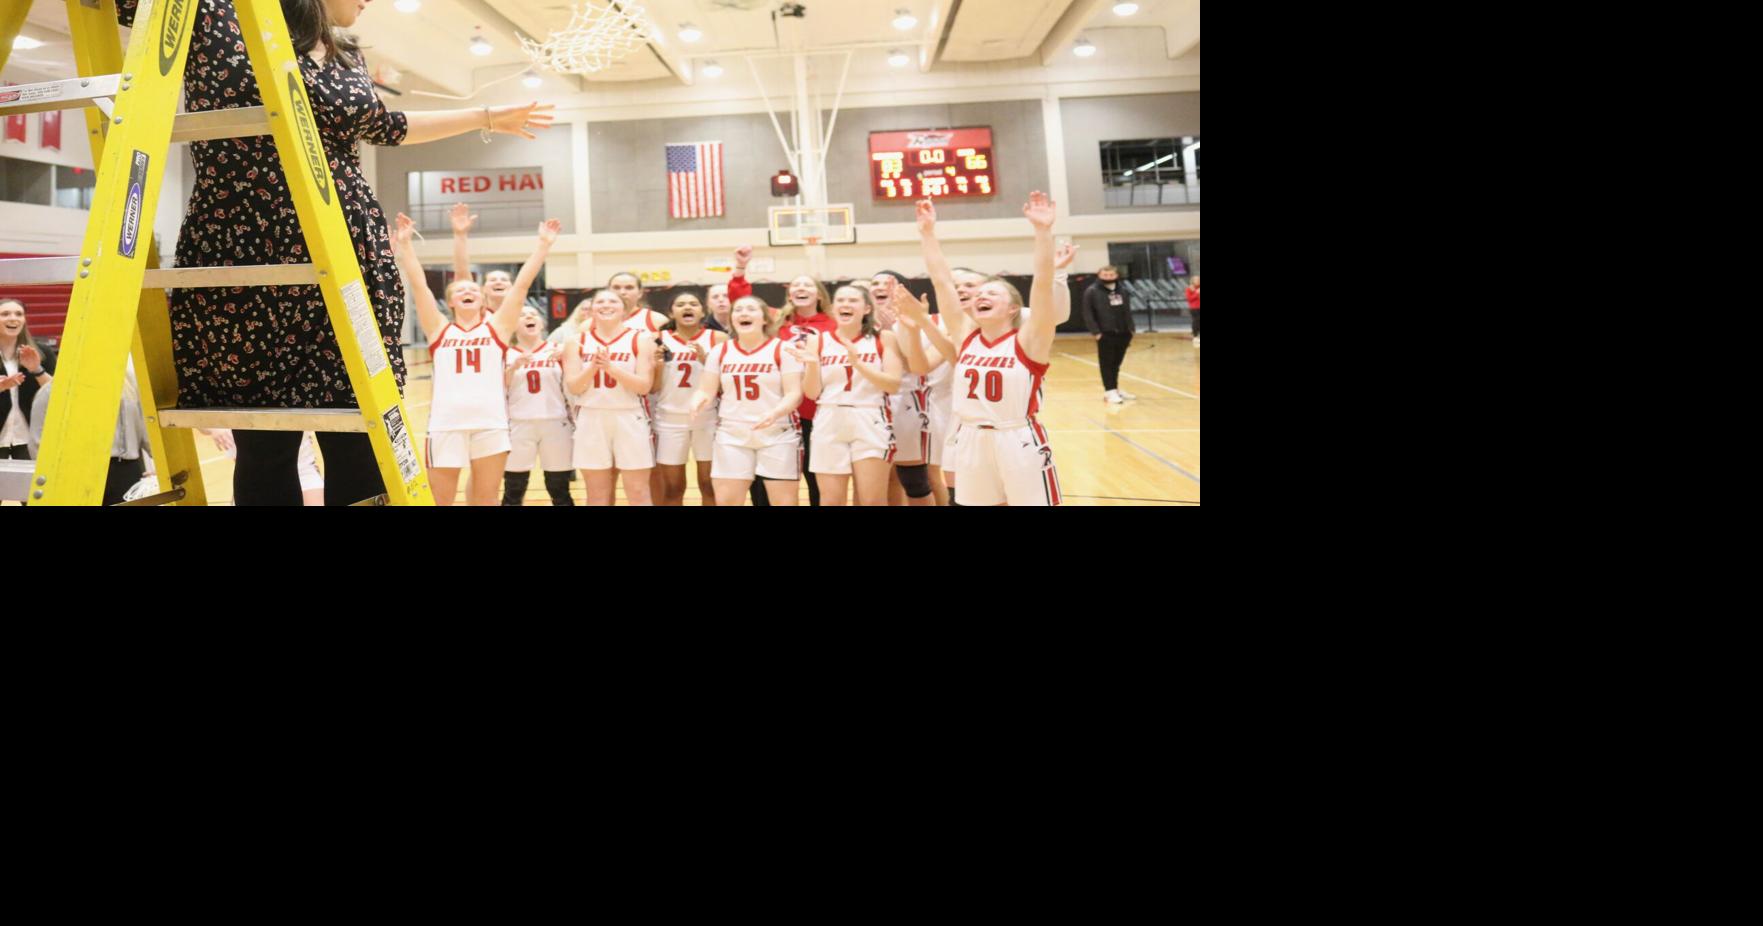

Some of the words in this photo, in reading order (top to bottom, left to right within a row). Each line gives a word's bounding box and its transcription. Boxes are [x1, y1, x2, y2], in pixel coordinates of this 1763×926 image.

[295, 100, 324, 181] WERNER
[441, 175, 492, 193] RED
[498, 173, 544, 191] HA
[126, 196, 139, 240] WERNER
[455, 347, 481, 374] 14
[677, 362, 692, 388] 2
[732, 374, 760, 401] 15
[964, 368, 1004, 403] 20
